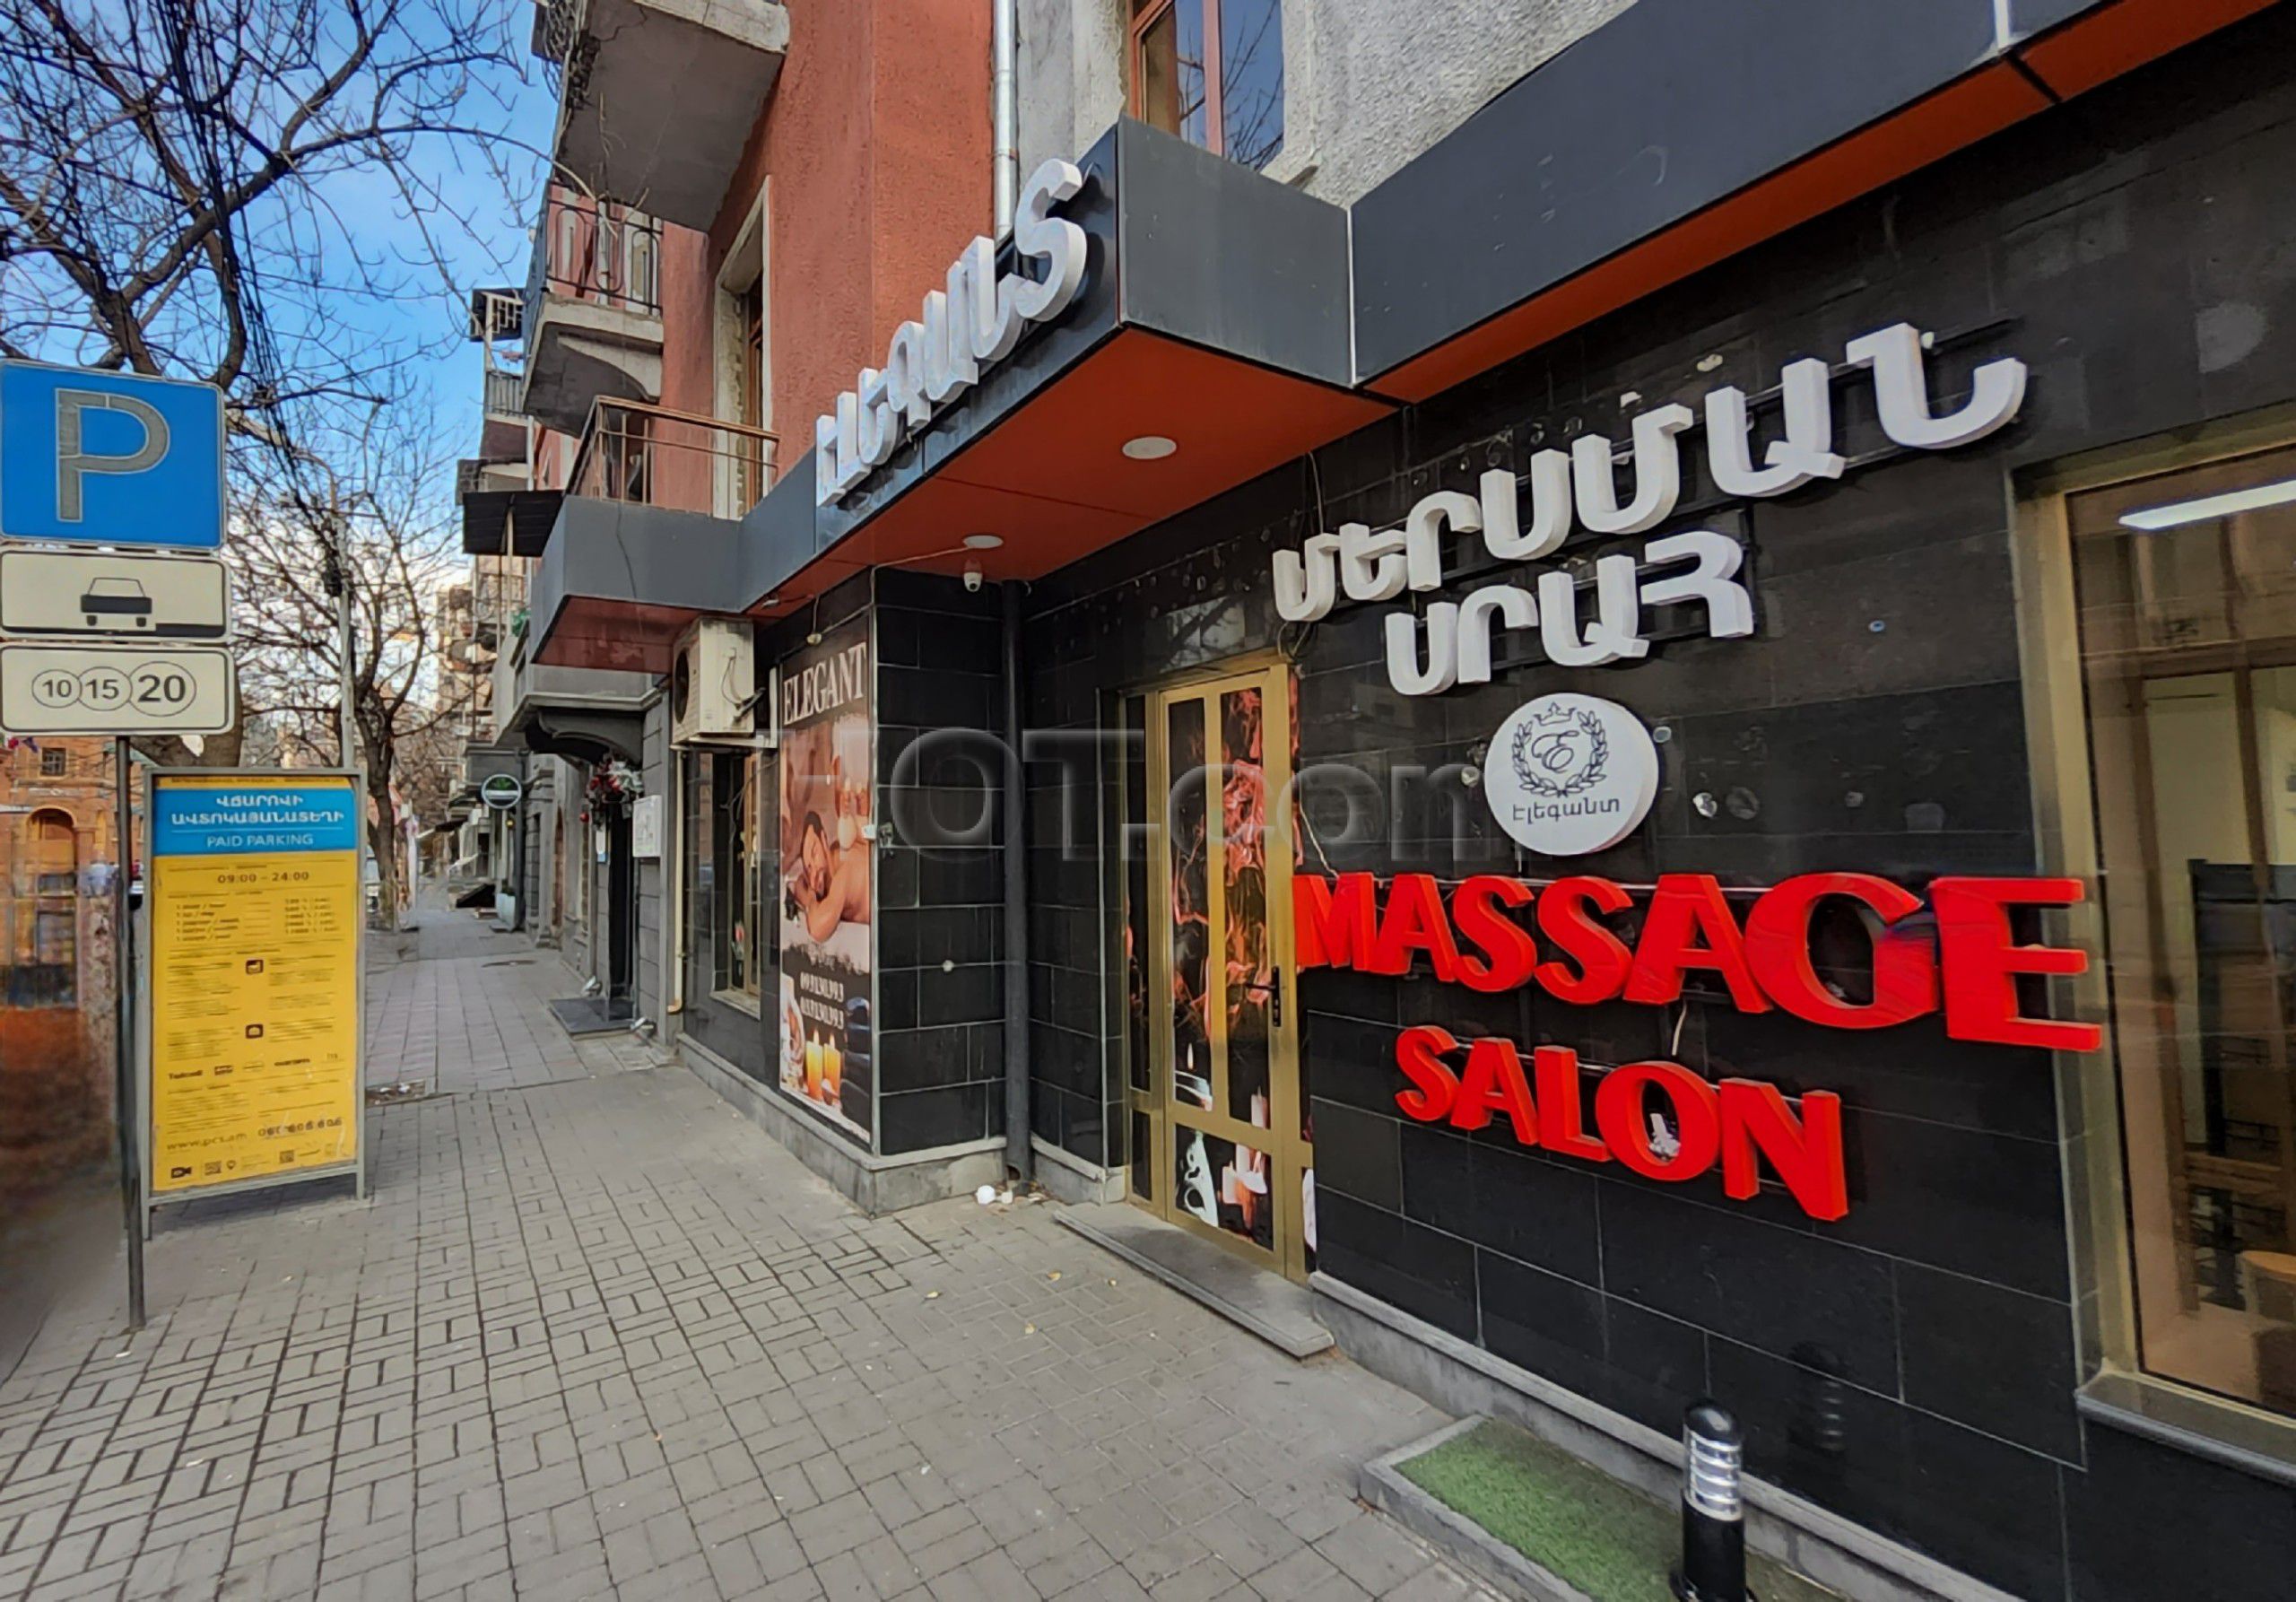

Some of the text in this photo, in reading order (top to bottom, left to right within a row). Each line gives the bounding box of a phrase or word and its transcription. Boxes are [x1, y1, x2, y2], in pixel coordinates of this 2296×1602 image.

[55, 387, 170, 523] P
[1386, 531, 1754, 696] ՍՐԱՀ
[42, 675, 187, 703] 10 15 20
[783, 641, 867, 727] ELEGANT
[206, 833, 314, 847] PAID PARKING
[272, 871, 309, 882] 24:00
[1292, 872, 2104, 1053] MASSAGE
[1395, 1025, 1849, 1223] SALON
